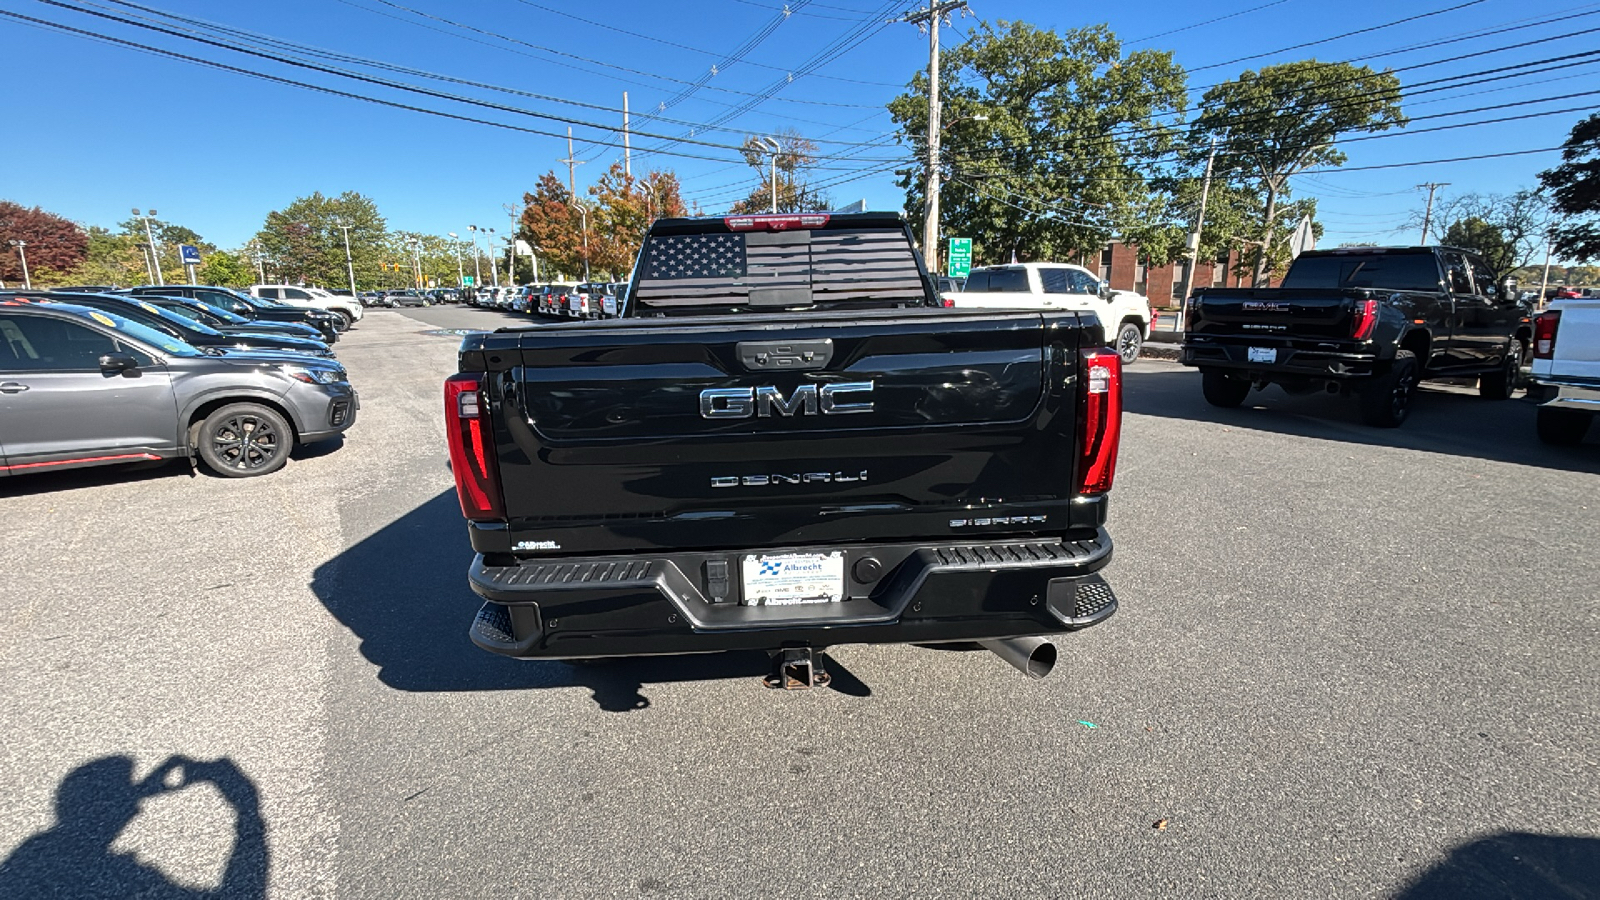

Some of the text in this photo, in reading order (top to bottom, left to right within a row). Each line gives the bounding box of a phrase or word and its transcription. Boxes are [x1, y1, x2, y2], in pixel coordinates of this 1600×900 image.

[1242, 301, 1290, 311] GMC
[699, 379, 875, 419] GMC
[710, 469, 868, 488] DENALI
[949, 514, 1048, 527] SIERRA
[783, 563, 823, 571] Albrecht
